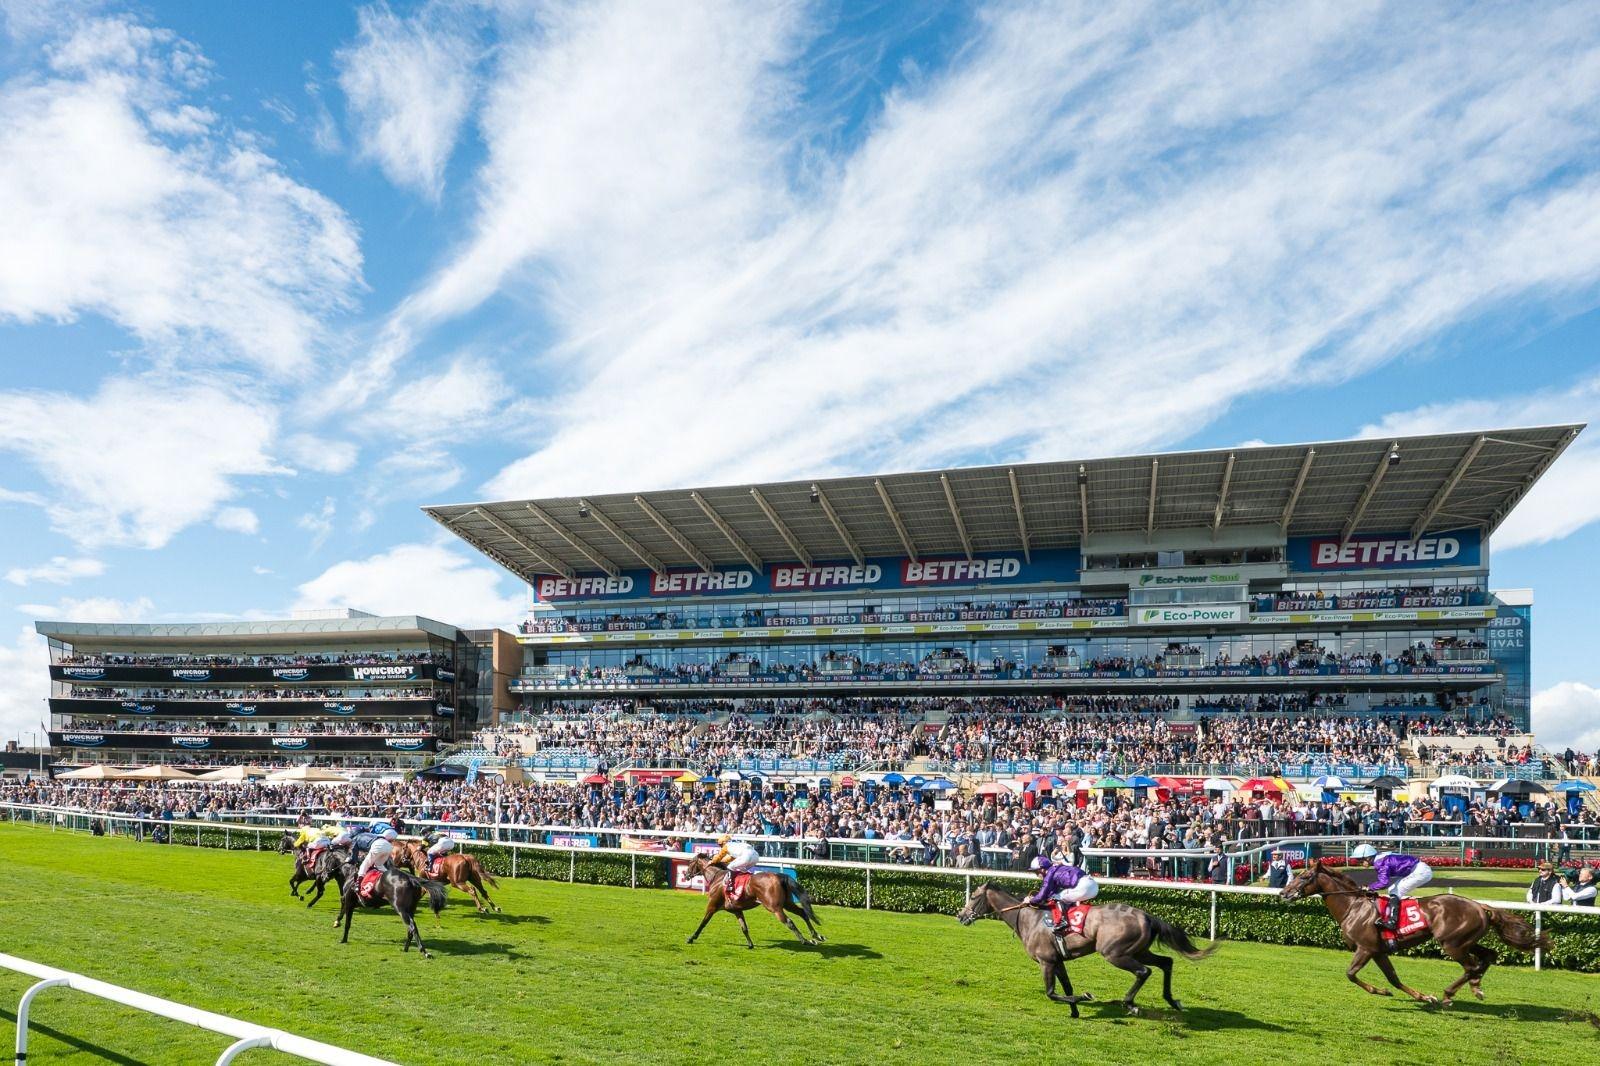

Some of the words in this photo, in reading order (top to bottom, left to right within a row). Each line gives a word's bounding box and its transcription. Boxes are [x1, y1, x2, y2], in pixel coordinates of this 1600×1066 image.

[1317, 538, 1460, 564] BETFRED
[775, 564, 882, 587] BETFRED
[906, 558, 1021, 582] BETFRED
[540, 576, 633, 597] BETFRED
[654, 570, 753, 592] BETFRED
[1156, 575, 1208, 585] Eco-Power
[1403, 596, 1462, 607] BETFRED
[1163, 610, 1235, 621] Eco-Power
[352, 666, 414, 680] HOWCROFT
[1070, 911, 1084, 926] 3
[1406, 906, 1420, 922] 5
